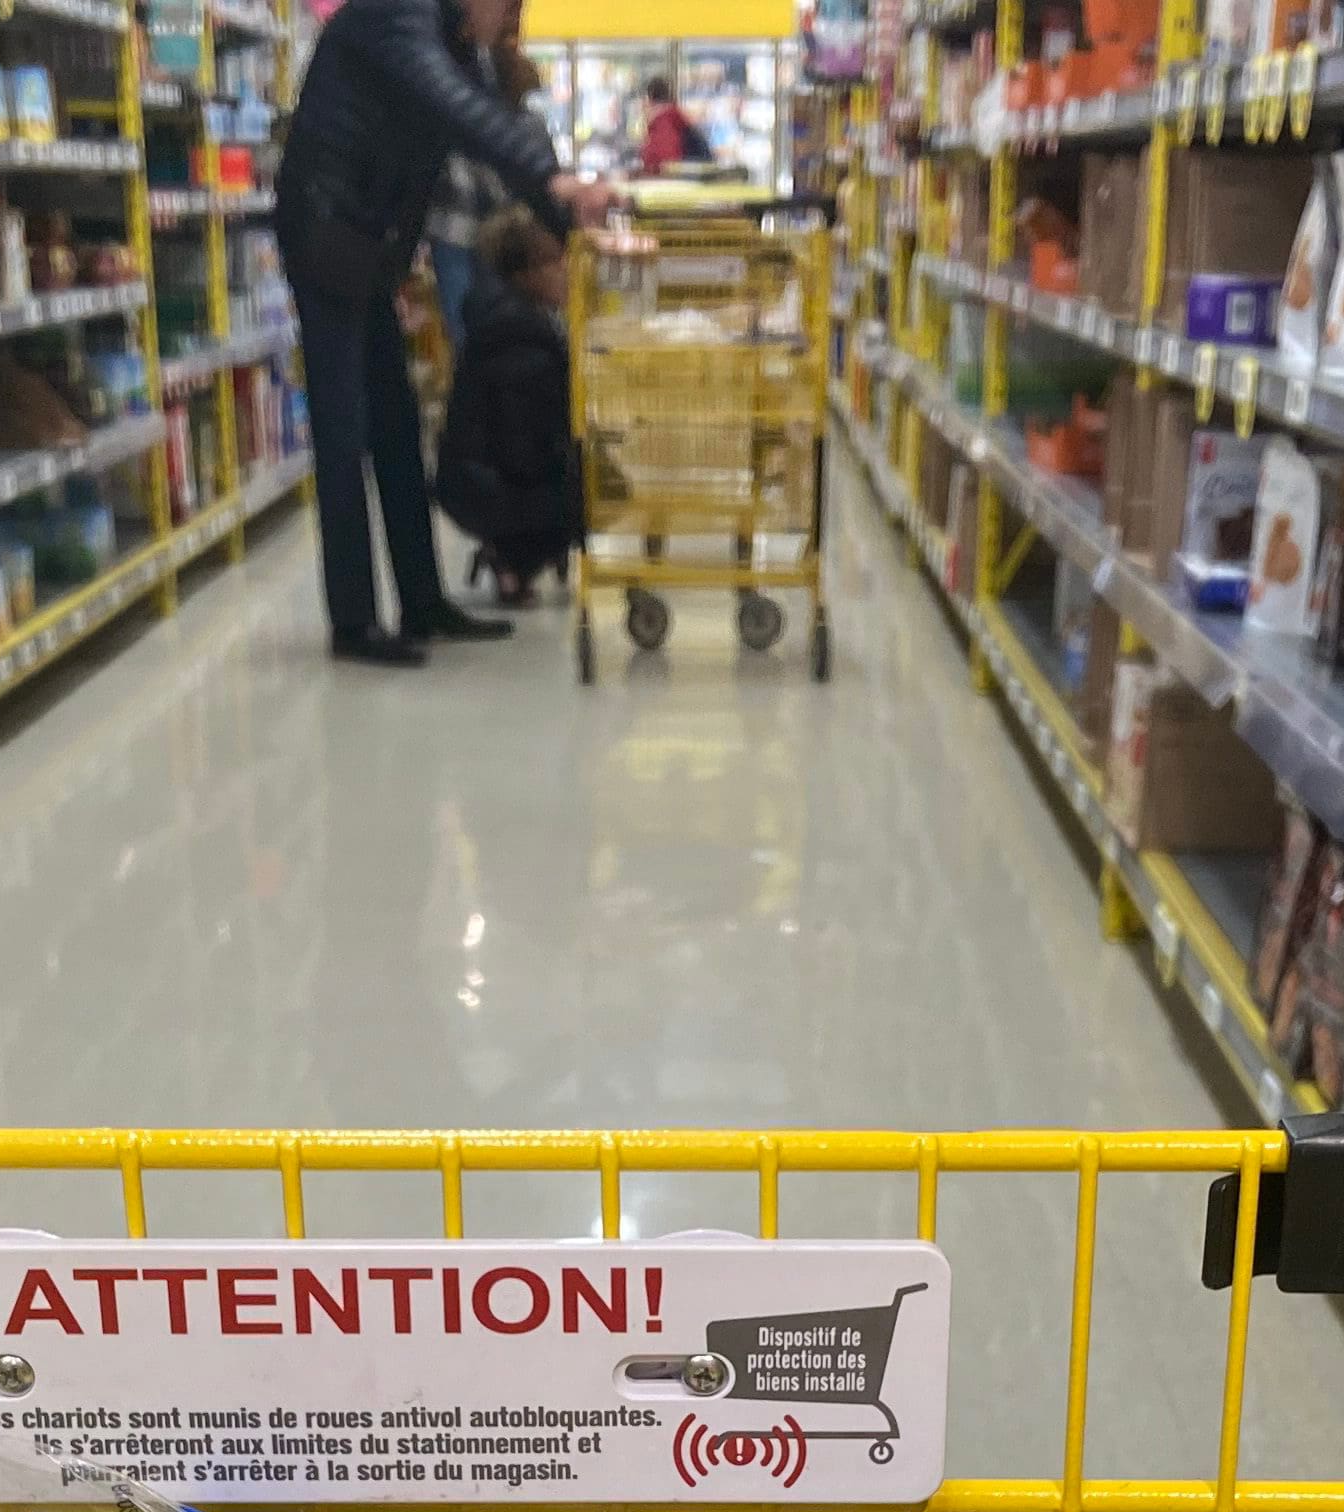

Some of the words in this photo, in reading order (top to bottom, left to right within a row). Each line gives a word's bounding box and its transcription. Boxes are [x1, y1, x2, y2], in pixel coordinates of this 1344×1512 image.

[759, 1327, 837, 1350] Dispositif
[841, 1327, 862, 1347] de
[747, 1351, 832, 1373] protection
[837, 1351, 866, 1369] des
[756, 1374, 800, 1392] biens
[805, 1371, 865, 1392] installé
[22, 1407, 122, 1429] chariots
[129, 1409, 181, 1429] sont
[189, 1408, 261, 1429] munis
[268, 1407, 297, 1429] de
[306, 1410, 374, 1429] roues
[381, 1407, 461, 1428] antivol
[470, 1405, 662, 1432] autobloquantes.
[35, 1434, 62, 1456] Ils
[71, 1432, 214, 1455] s'arrêteront
[222, 1438, 264, 1454] aux
[272, 1435, 353, 1455] limites
[360, 1434, 390, 1454] du
[397, 1434, 570, 1454] stationnement
[578, 1433, 602, 1454] et
[61, 1461, 187, 1486] pourraient
[194, 1459, 297, 1481] s'arrêter
[306, 1459, 319, 1481] à
[327, 1460, 350, 1481] la
[357, 1460, 425, 1481] sortie
[433, 1460, 463, 1481] du
[471, 1460, 579, 1487] magasin.
